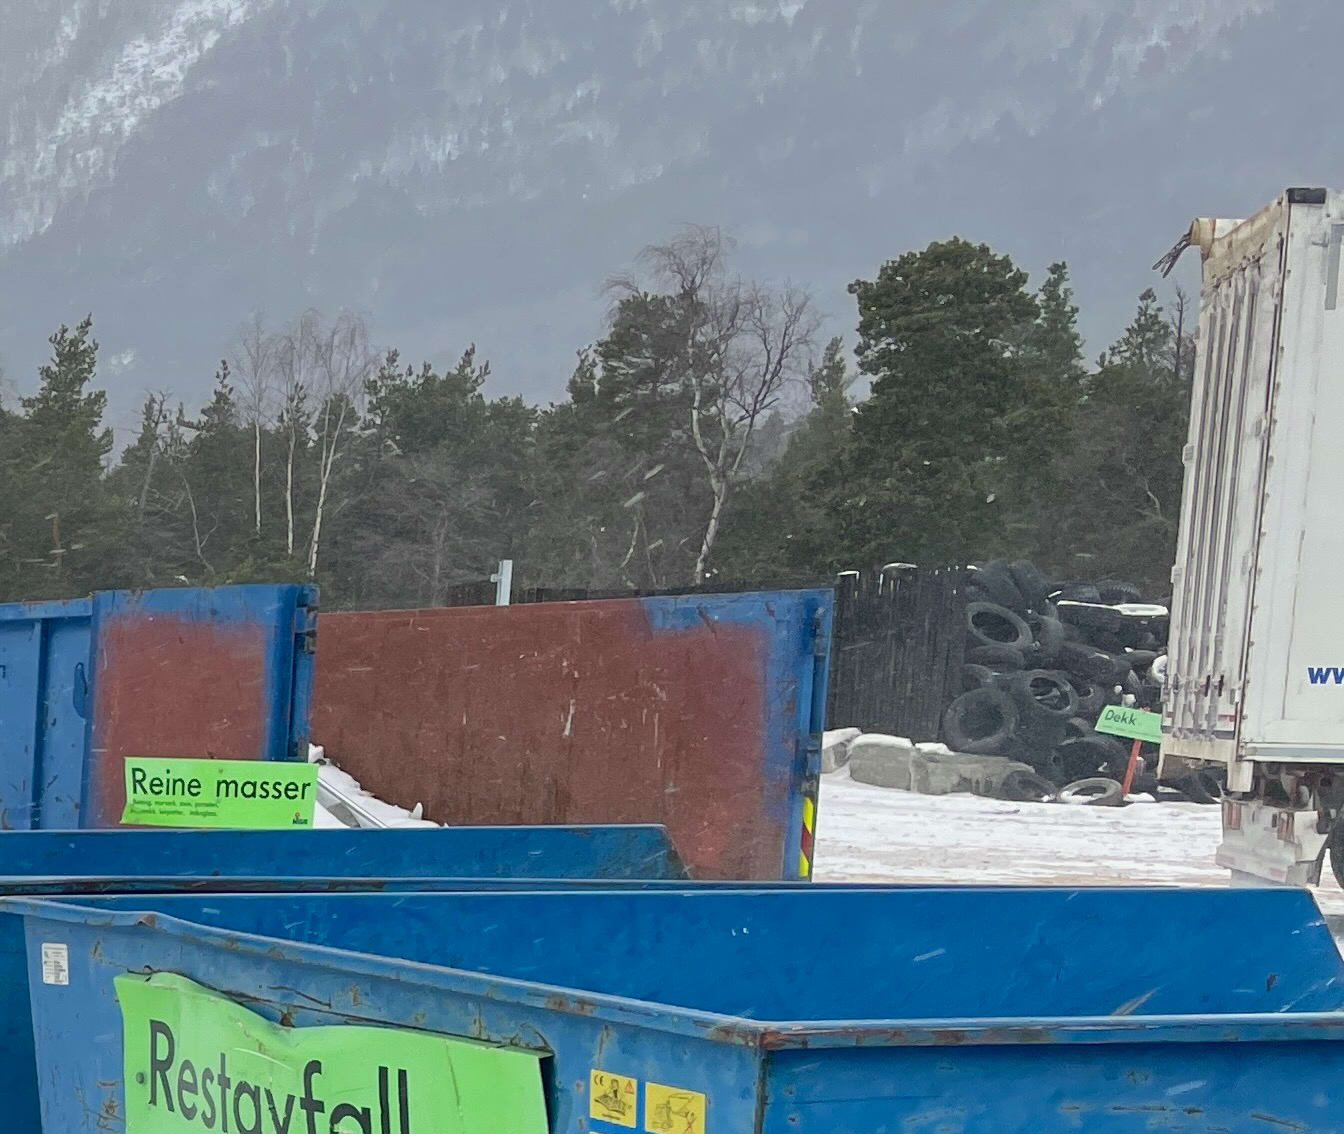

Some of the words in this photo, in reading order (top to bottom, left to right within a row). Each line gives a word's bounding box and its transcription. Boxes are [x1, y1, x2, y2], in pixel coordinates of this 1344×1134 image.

[1105, 709, 1136, 726] Dekk
[131, 767, 202, 797] Reine
[216, 778, 311, 800] masser
